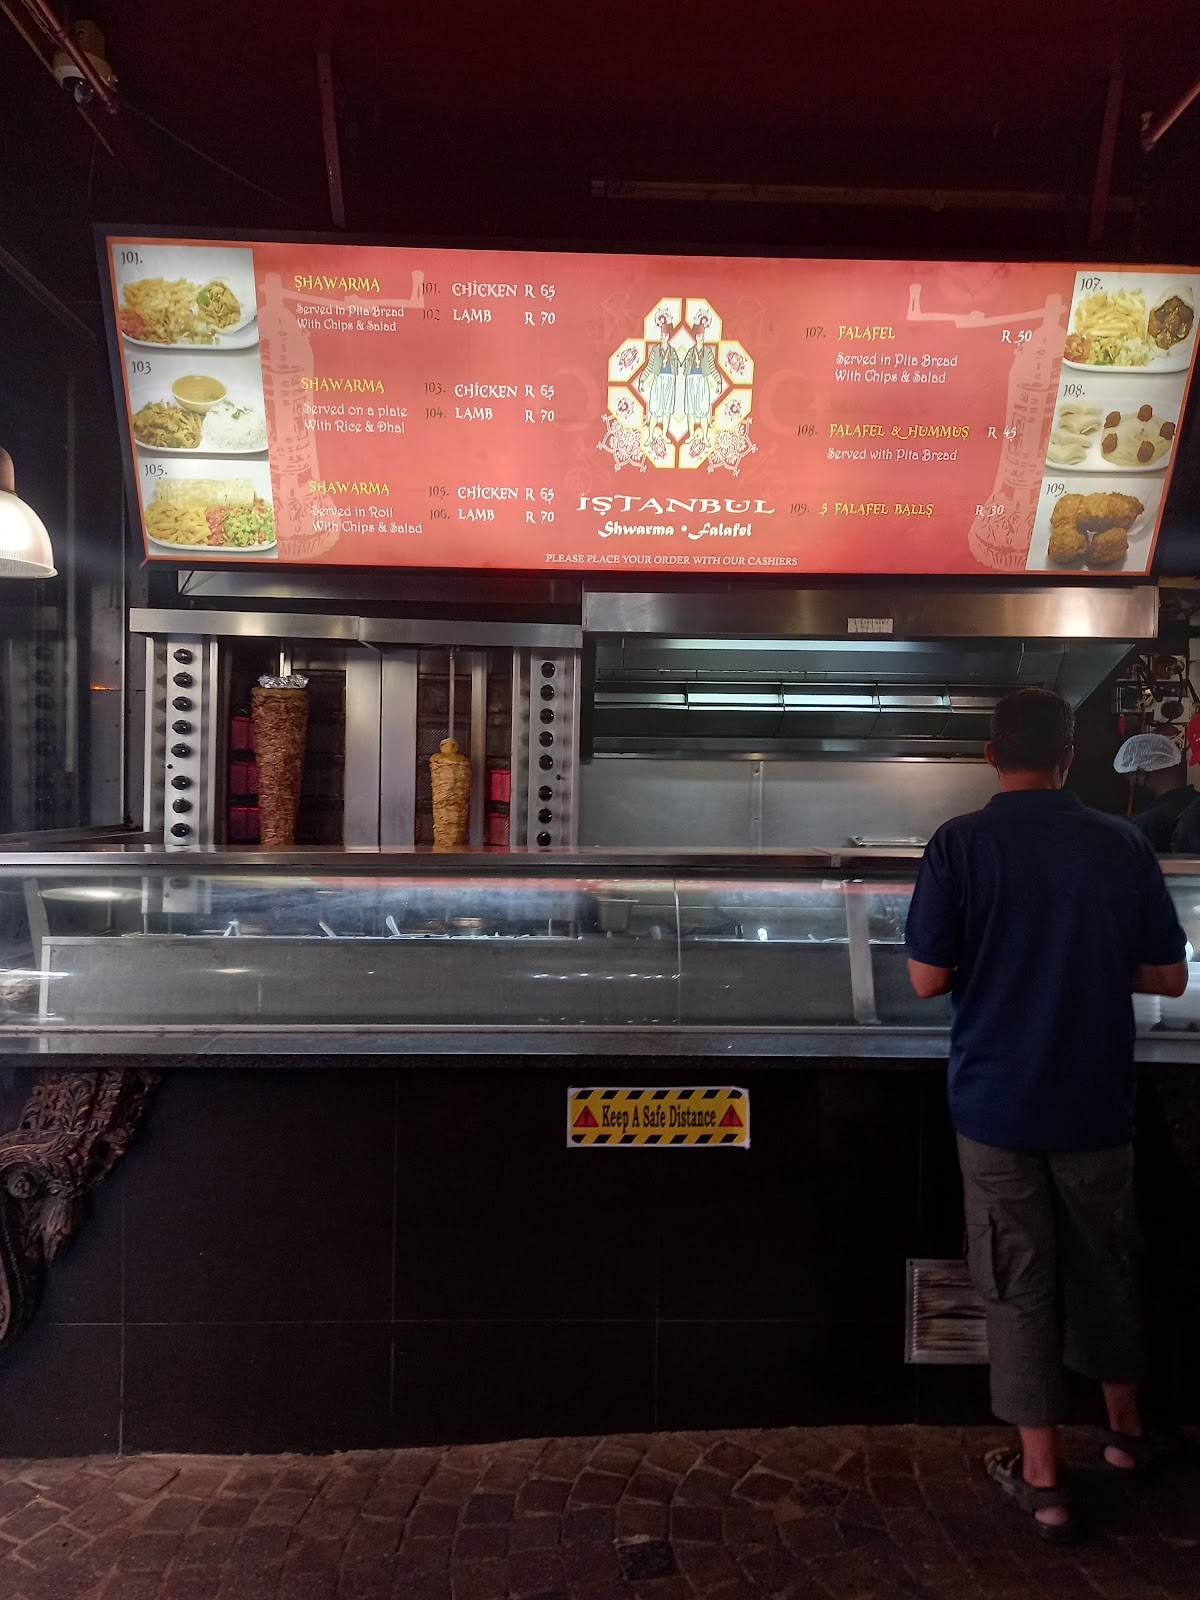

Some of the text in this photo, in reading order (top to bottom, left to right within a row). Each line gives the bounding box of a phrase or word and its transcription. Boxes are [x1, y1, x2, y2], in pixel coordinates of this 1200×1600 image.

[121, 251, 143, 265] 101.
[294, 274, 381, 293] SHAWARMA
[451, 280, 518, 298] CHICKEN
[524, 284, 536, 298] R
[540, 284, 556, 302] 65
[1080, 276, 1103, 292] 107.
[296, 303, 404, 318] Served in Pita Bread
[453, 308, 492, 324] LAMB
[524, 311, 536, 326] R
[540, 311, 556, 326] 70
[297, 318, 397, 332] With Chips & Salad
[805, 325, 896, 341] 107. FALAFEL
[1001, 329, 1032, 346] R 50
[131, 360, 152, 374] 103
[835, 352, 958, 368] Served in Pita Bread
[834, 369, 946, 384] With Chips & Salad
[300, 377, 385, 394] SHAWARMA
[454, 381, 518, 399] CHICKEN
[525, 384, 535, 399] R
[540, 384, 555, 401] 65
[1063, 383, 1086, 398] 108.
[303, 402, 408, 419] Served on a plate
[455, 406, 493, 421] LAMB
[524, 409, 535, 424] R
[540, 409, 555, 424] 70
[303, 419, 405, 433] With Rice & Dhal
[829, 423, 885, 439] FALAFEL
[899, 425, 970, 441] HUMMUS
[986, 426, 998, 439] R
[1003, 426, 1017, 442] 45
[826, 447, 957, 462] Served with Pita Bread
[144, 463, 168, 479] 105.
[308, 480, 390, 496] SHAWARMA
[457, 484, 519, 500] CHICKEN
[525, 487, 536, 502] R
[540, 487, 555, 504] 65
[1046, 482, 1068, 498] 109.
[311, 504, 352, 517] Served
[355, 505, 366, 517] in
[458, 507, 495, 522] LAMB
[525, 510, 536, 524] R
[540, 510, 555, 524] 70
[818, 502, 828, 518] 5
[834, 502, 889, 517] FALAFEL
[894, 503, 934, 518] BALLS
[975, 504, 1005, 518] R 30
[312, 520, 423, 535] With Chips & Salad
[597, 520, 753, 540] Shwarma Falafel
[545, 553, 798, 567] PLEASE PLACE YOUR ORDER WITH OUR CASHIERS
[602, 1105, 717, 1133] Keep A Safe Distance
